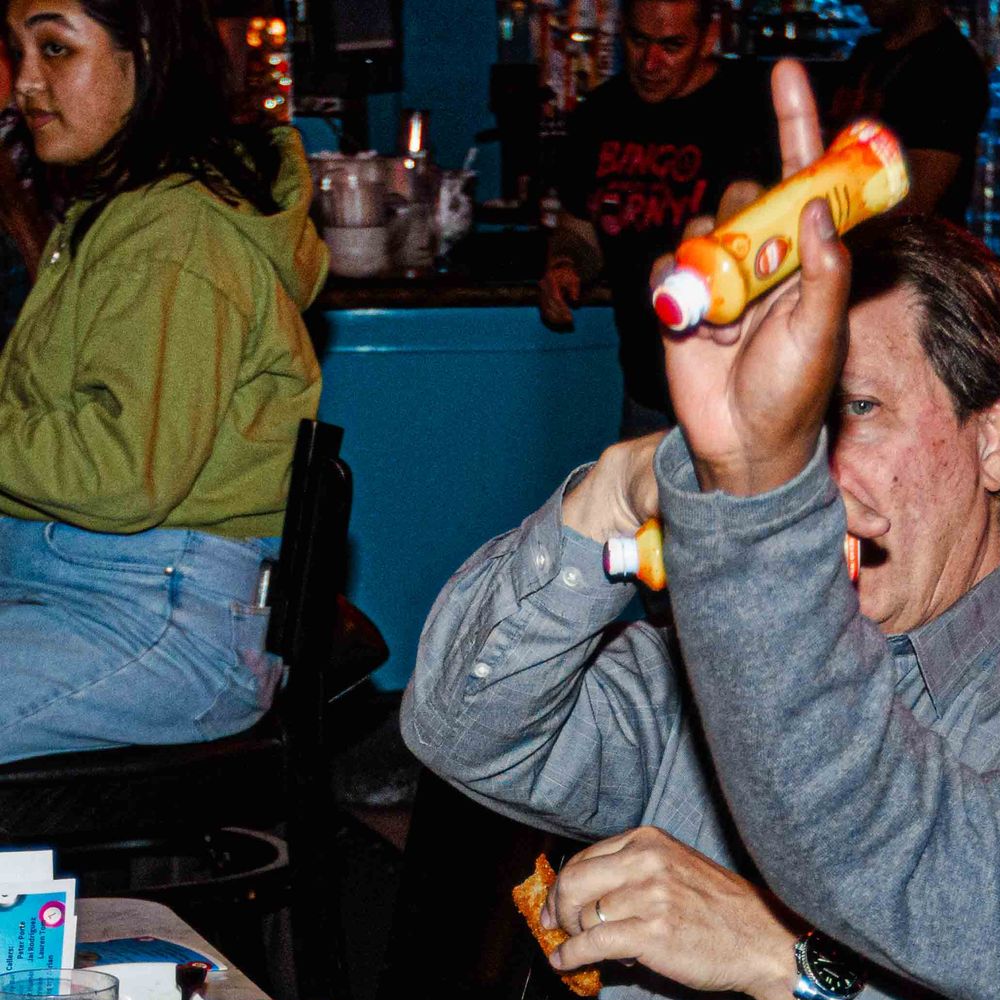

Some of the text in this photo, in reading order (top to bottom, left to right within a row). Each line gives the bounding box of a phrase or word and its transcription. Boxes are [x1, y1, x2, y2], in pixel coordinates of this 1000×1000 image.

[597, 141, 702, 182] BINGO
[28, 917, 37, 951] Rodriguez
[38, 936, 46, 960] Lauren
[6, 946, 14, 971] Callers:
